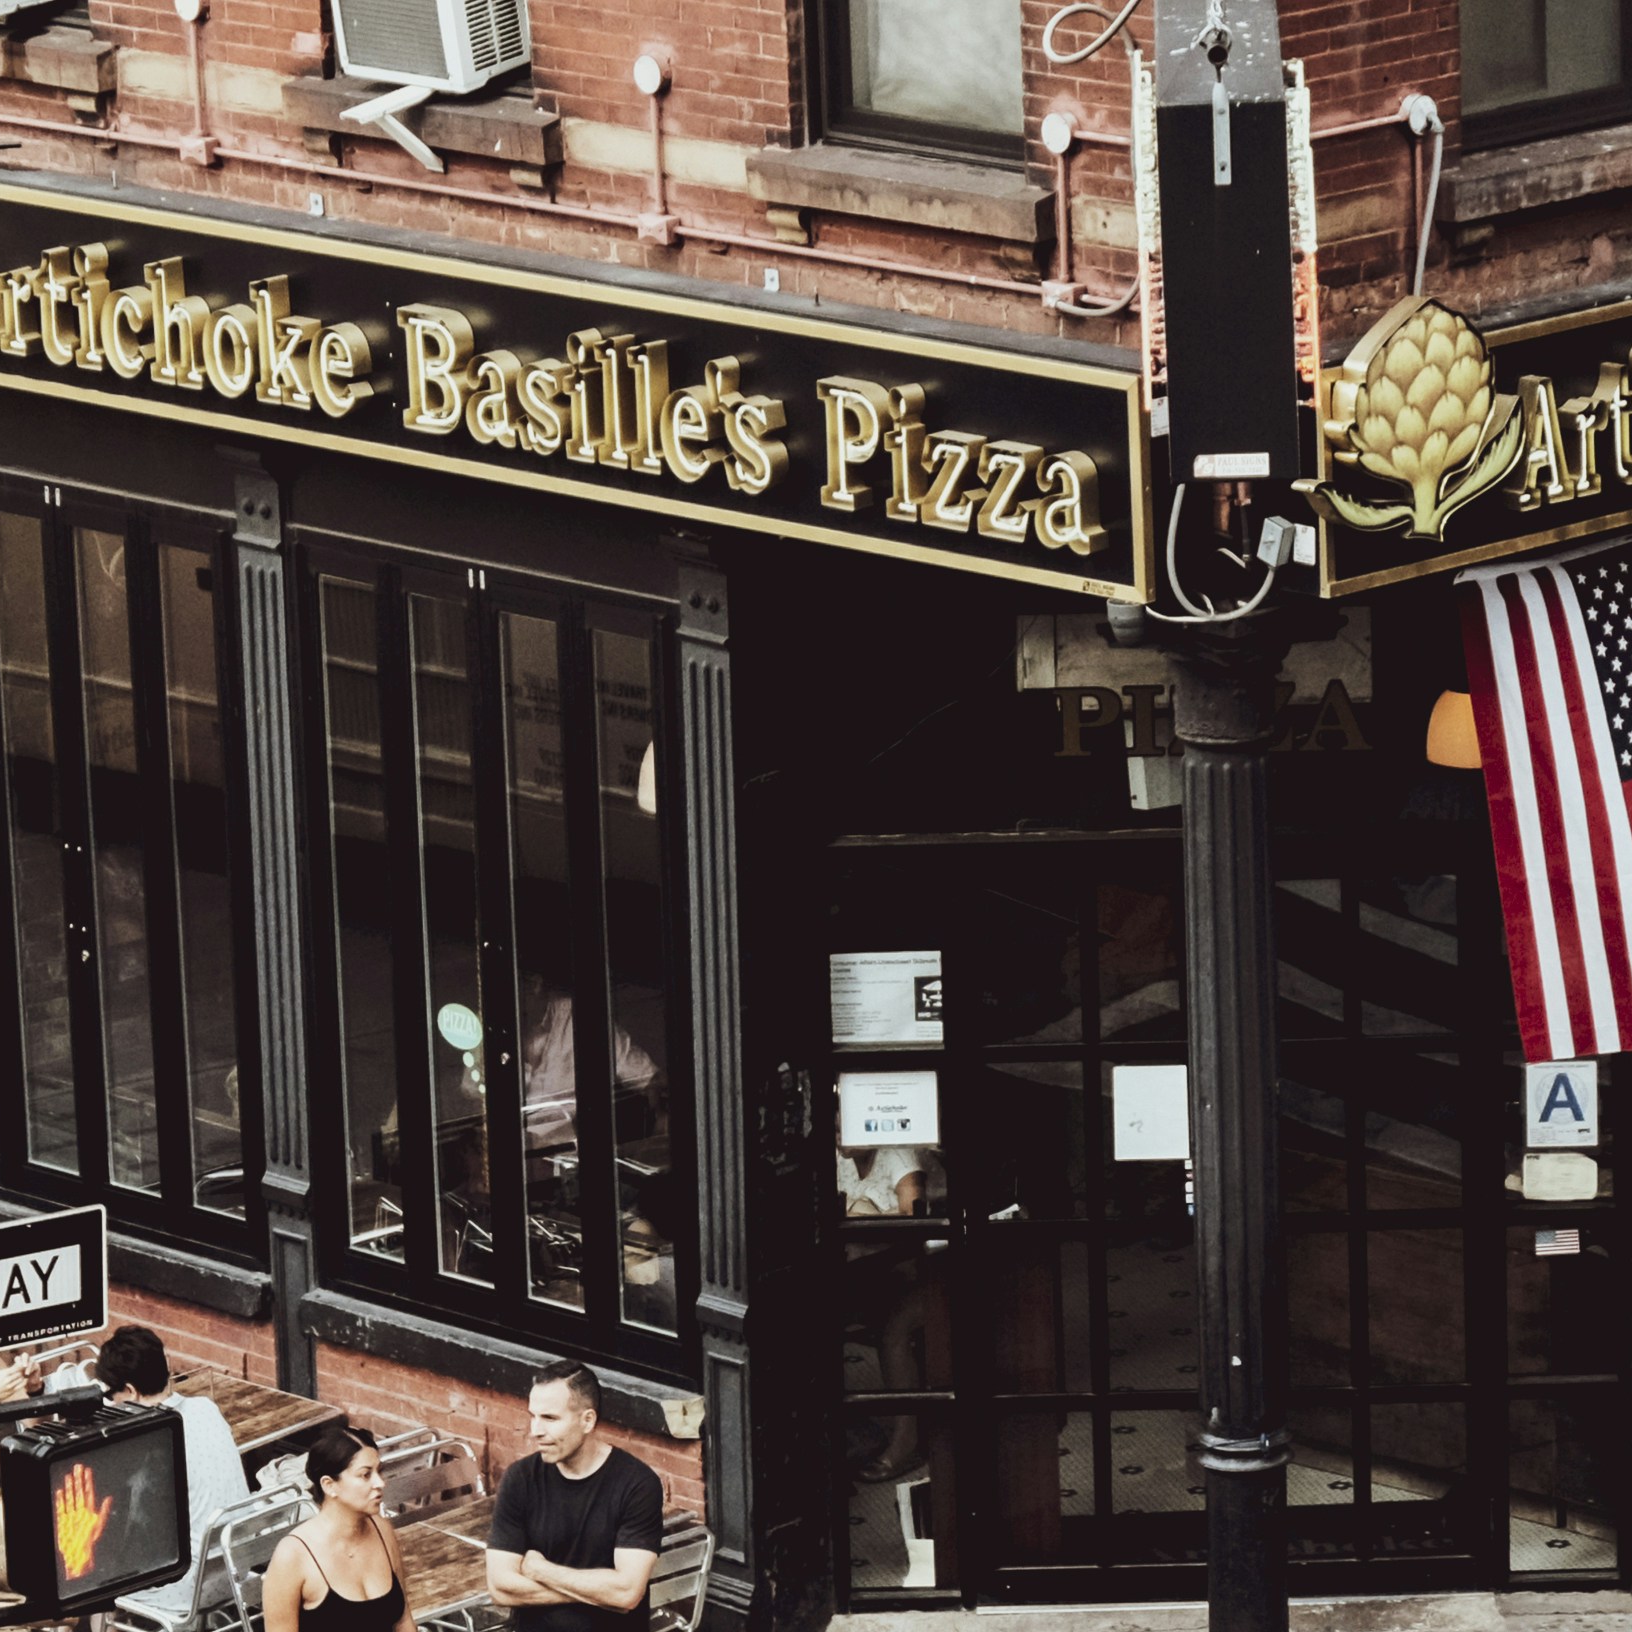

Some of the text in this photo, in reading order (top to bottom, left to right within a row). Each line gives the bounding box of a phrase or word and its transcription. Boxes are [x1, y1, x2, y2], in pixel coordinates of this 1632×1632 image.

[397, 301, 786, 495] Basille's
[814, 373, 1108, 555] Pizza
[1053, 678, 1373, 757] PIA
[1539, 1072, 1585, 1122] A
[8, 1320, 93, 1341] TRANSPORTATION
